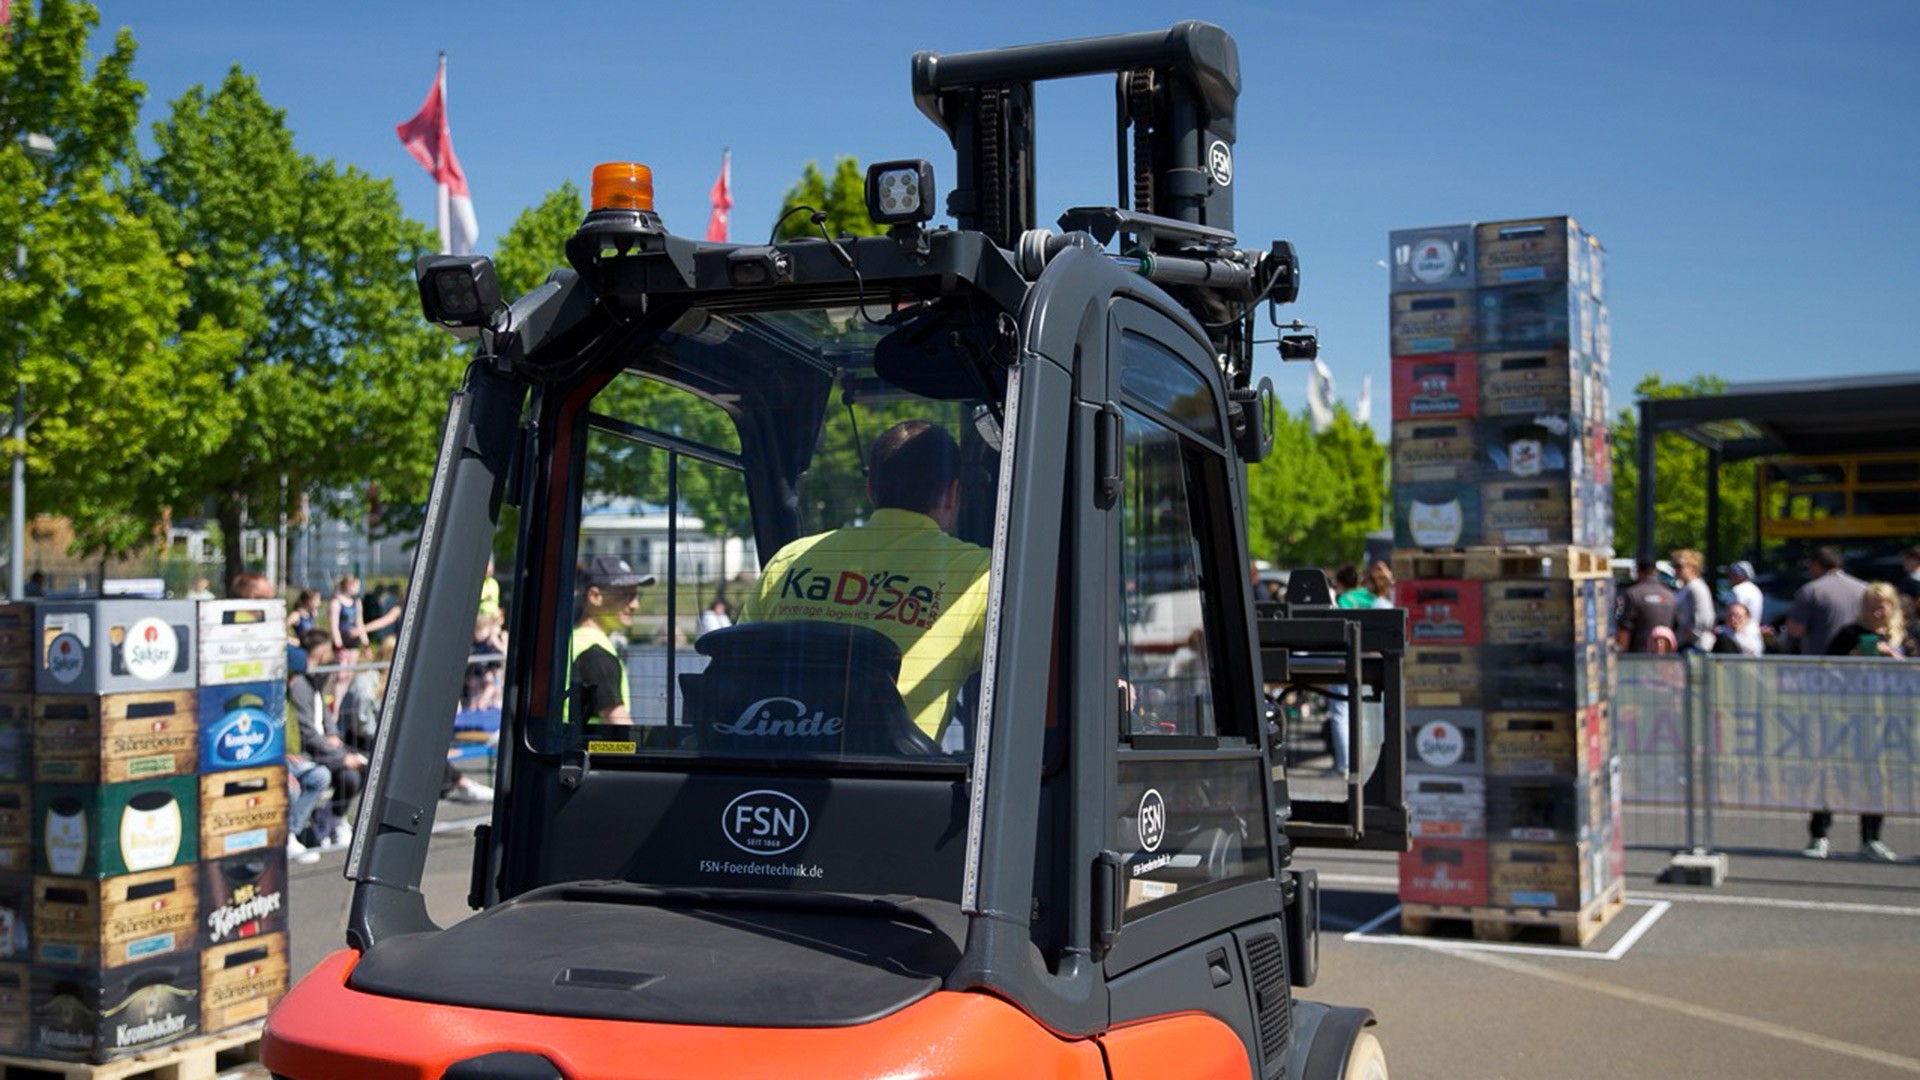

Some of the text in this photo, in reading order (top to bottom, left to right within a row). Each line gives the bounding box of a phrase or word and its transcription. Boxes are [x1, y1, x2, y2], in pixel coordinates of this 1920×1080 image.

[1212, 149, 1230, 175] FSN
[712, 697, 844, 737] Linde
[735, 805, 796, 838] FSN
[1142, 802, 1162, 836] FSN
[746, 837, 781, 848] SEIT 1868
[699, 860, 824, 878] FSN-Foerdertechnik.de
[116, 1012, 188, 1046] Krombacher
